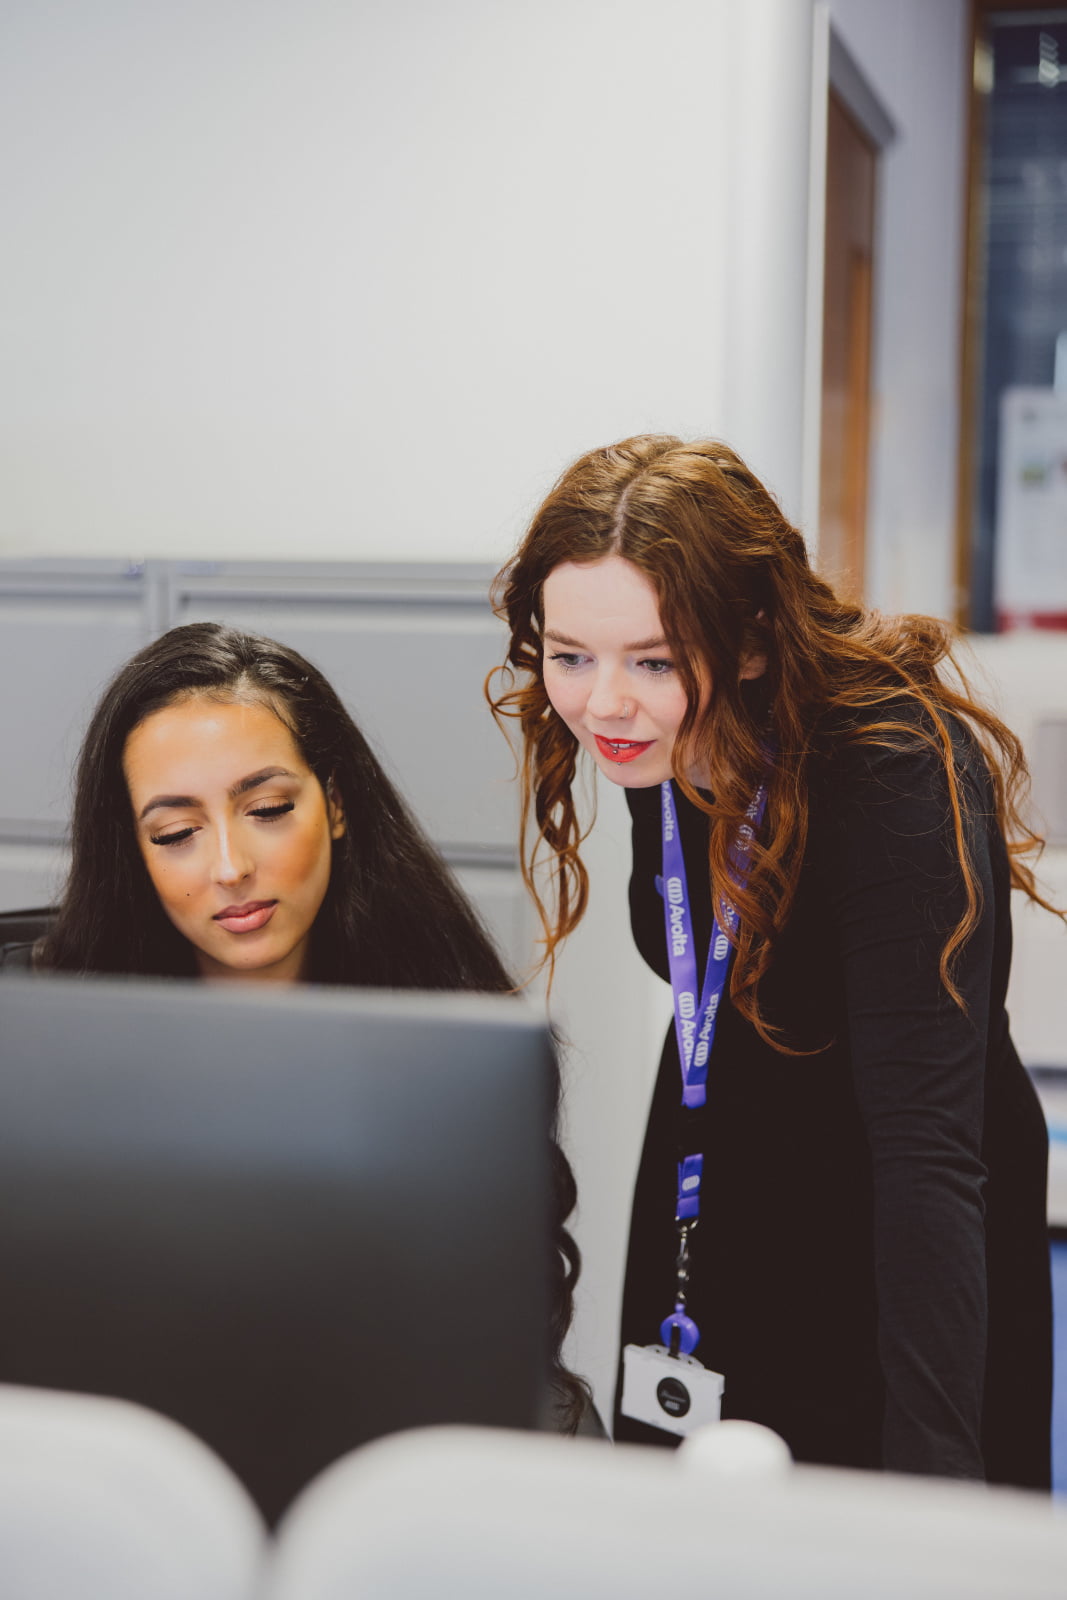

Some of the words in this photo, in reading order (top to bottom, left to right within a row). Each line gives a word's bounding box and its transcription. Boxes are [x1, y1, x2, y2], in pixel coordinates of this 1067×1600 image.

[662, 790, 675, 841] Avolta
[670, 905, 688, 957] Avolta
[699, 993, 719, 1041] Avolta
